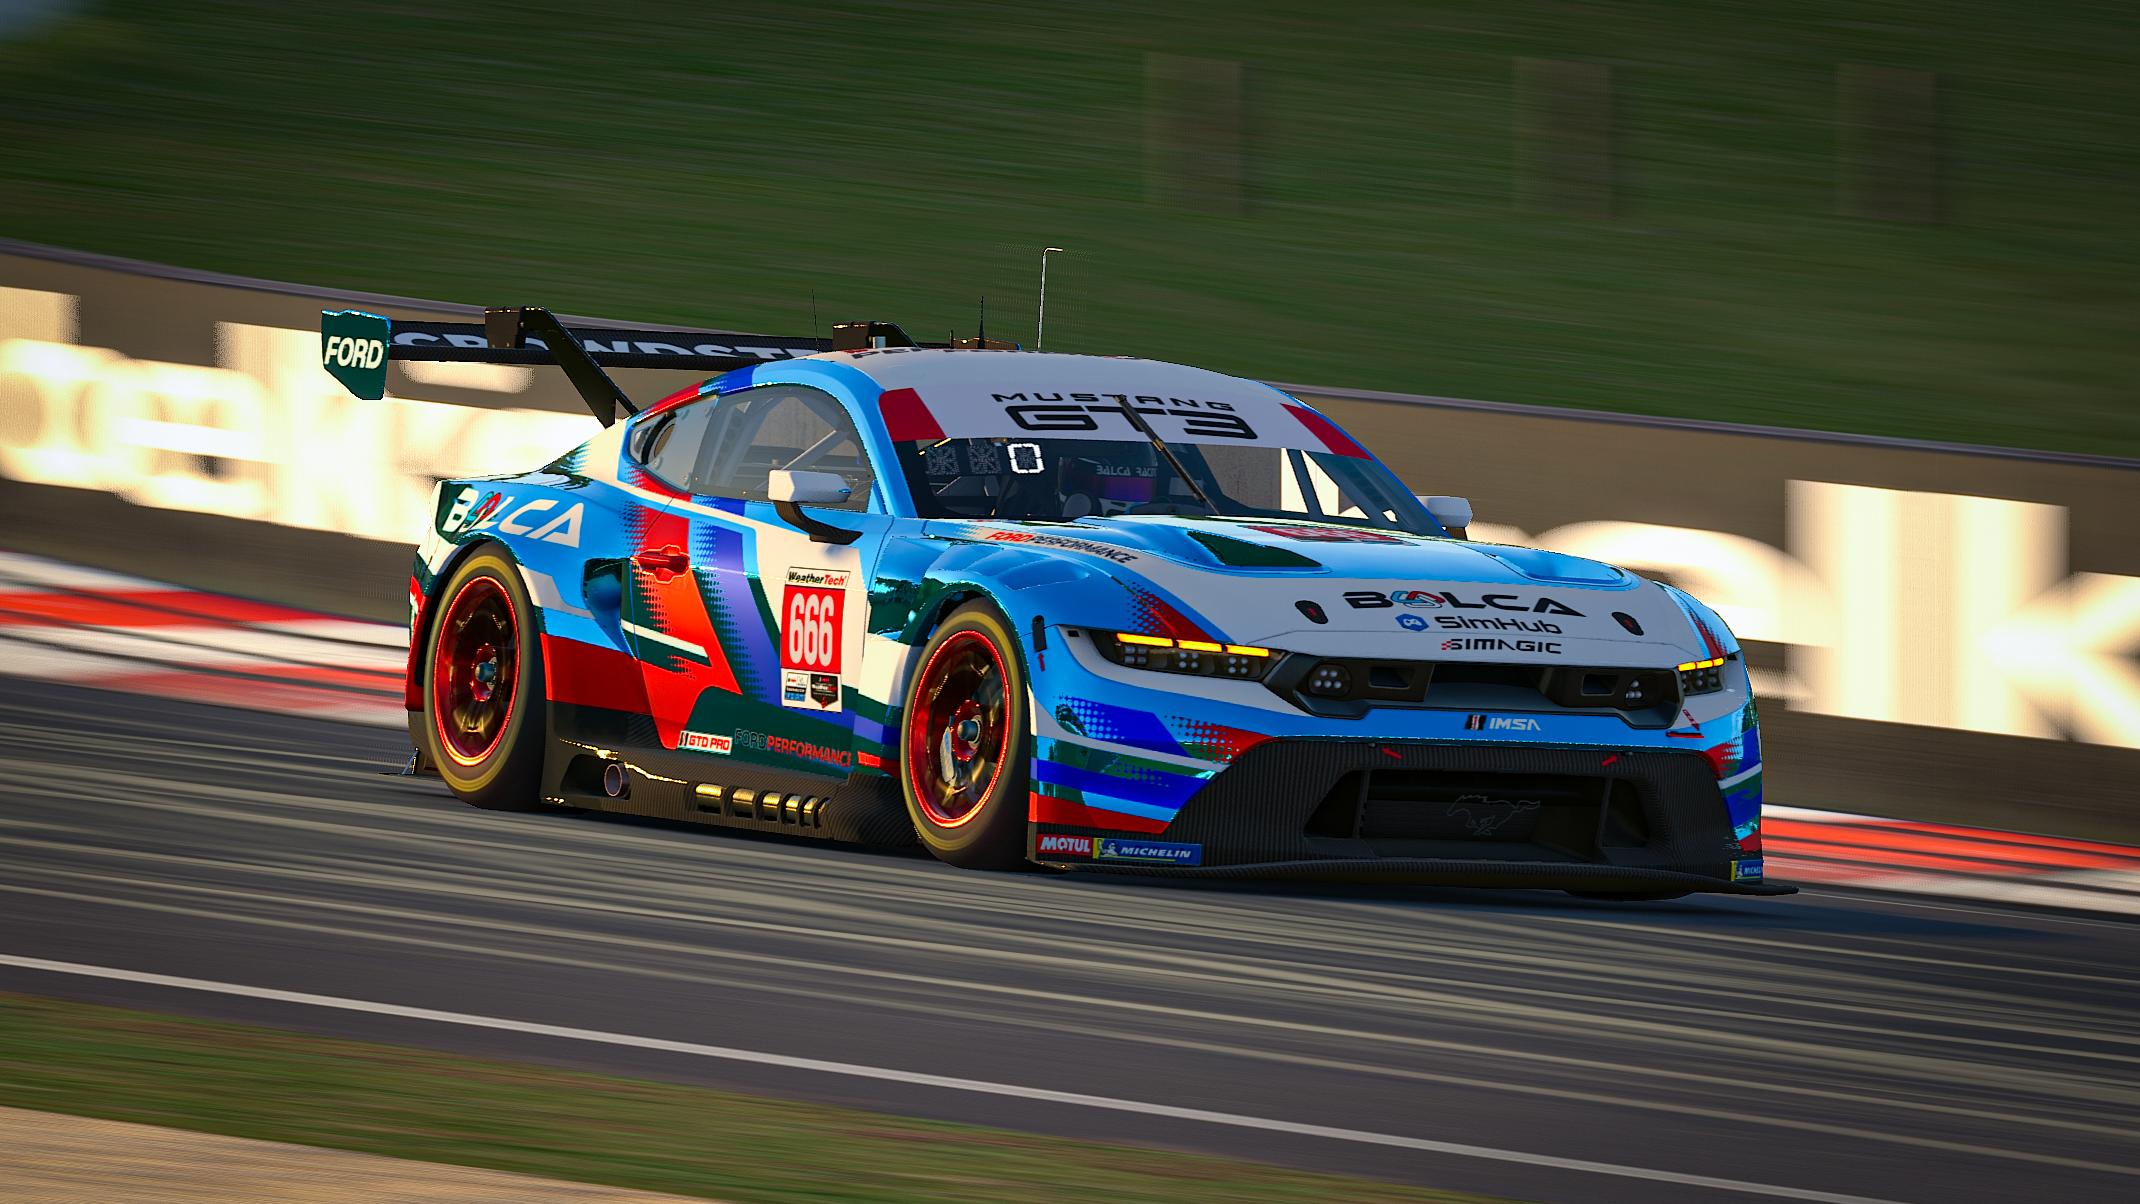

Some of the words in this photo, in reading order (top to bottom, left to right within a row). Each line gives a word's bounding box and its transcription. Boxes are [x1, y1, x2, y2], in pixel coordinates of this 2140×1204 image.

[324, 336, 384, 369] FORD
[991, 393, 1235, 412] MUSTANG
[1005, 405, 1258, 439] GT3
[442, 487, 584, 548] BALCA
[788, 571, 845, 586] WeatherTech
[1342, 590, 1588, 618] BALCA
[789, 592, 835, 667] 666
[1434, 616, 1563, 635] SimHub
[1447, 638, 1562, 655] SIMAGIC
[1489, 717, 1542, 731] IMSA
[689, 735, 708, 748] GTD
[710, 738, 730, 751] PRO
[1040, 836, 1091, 853] MOTUL
[1120, 846, 1191, 858] MICHELIN
